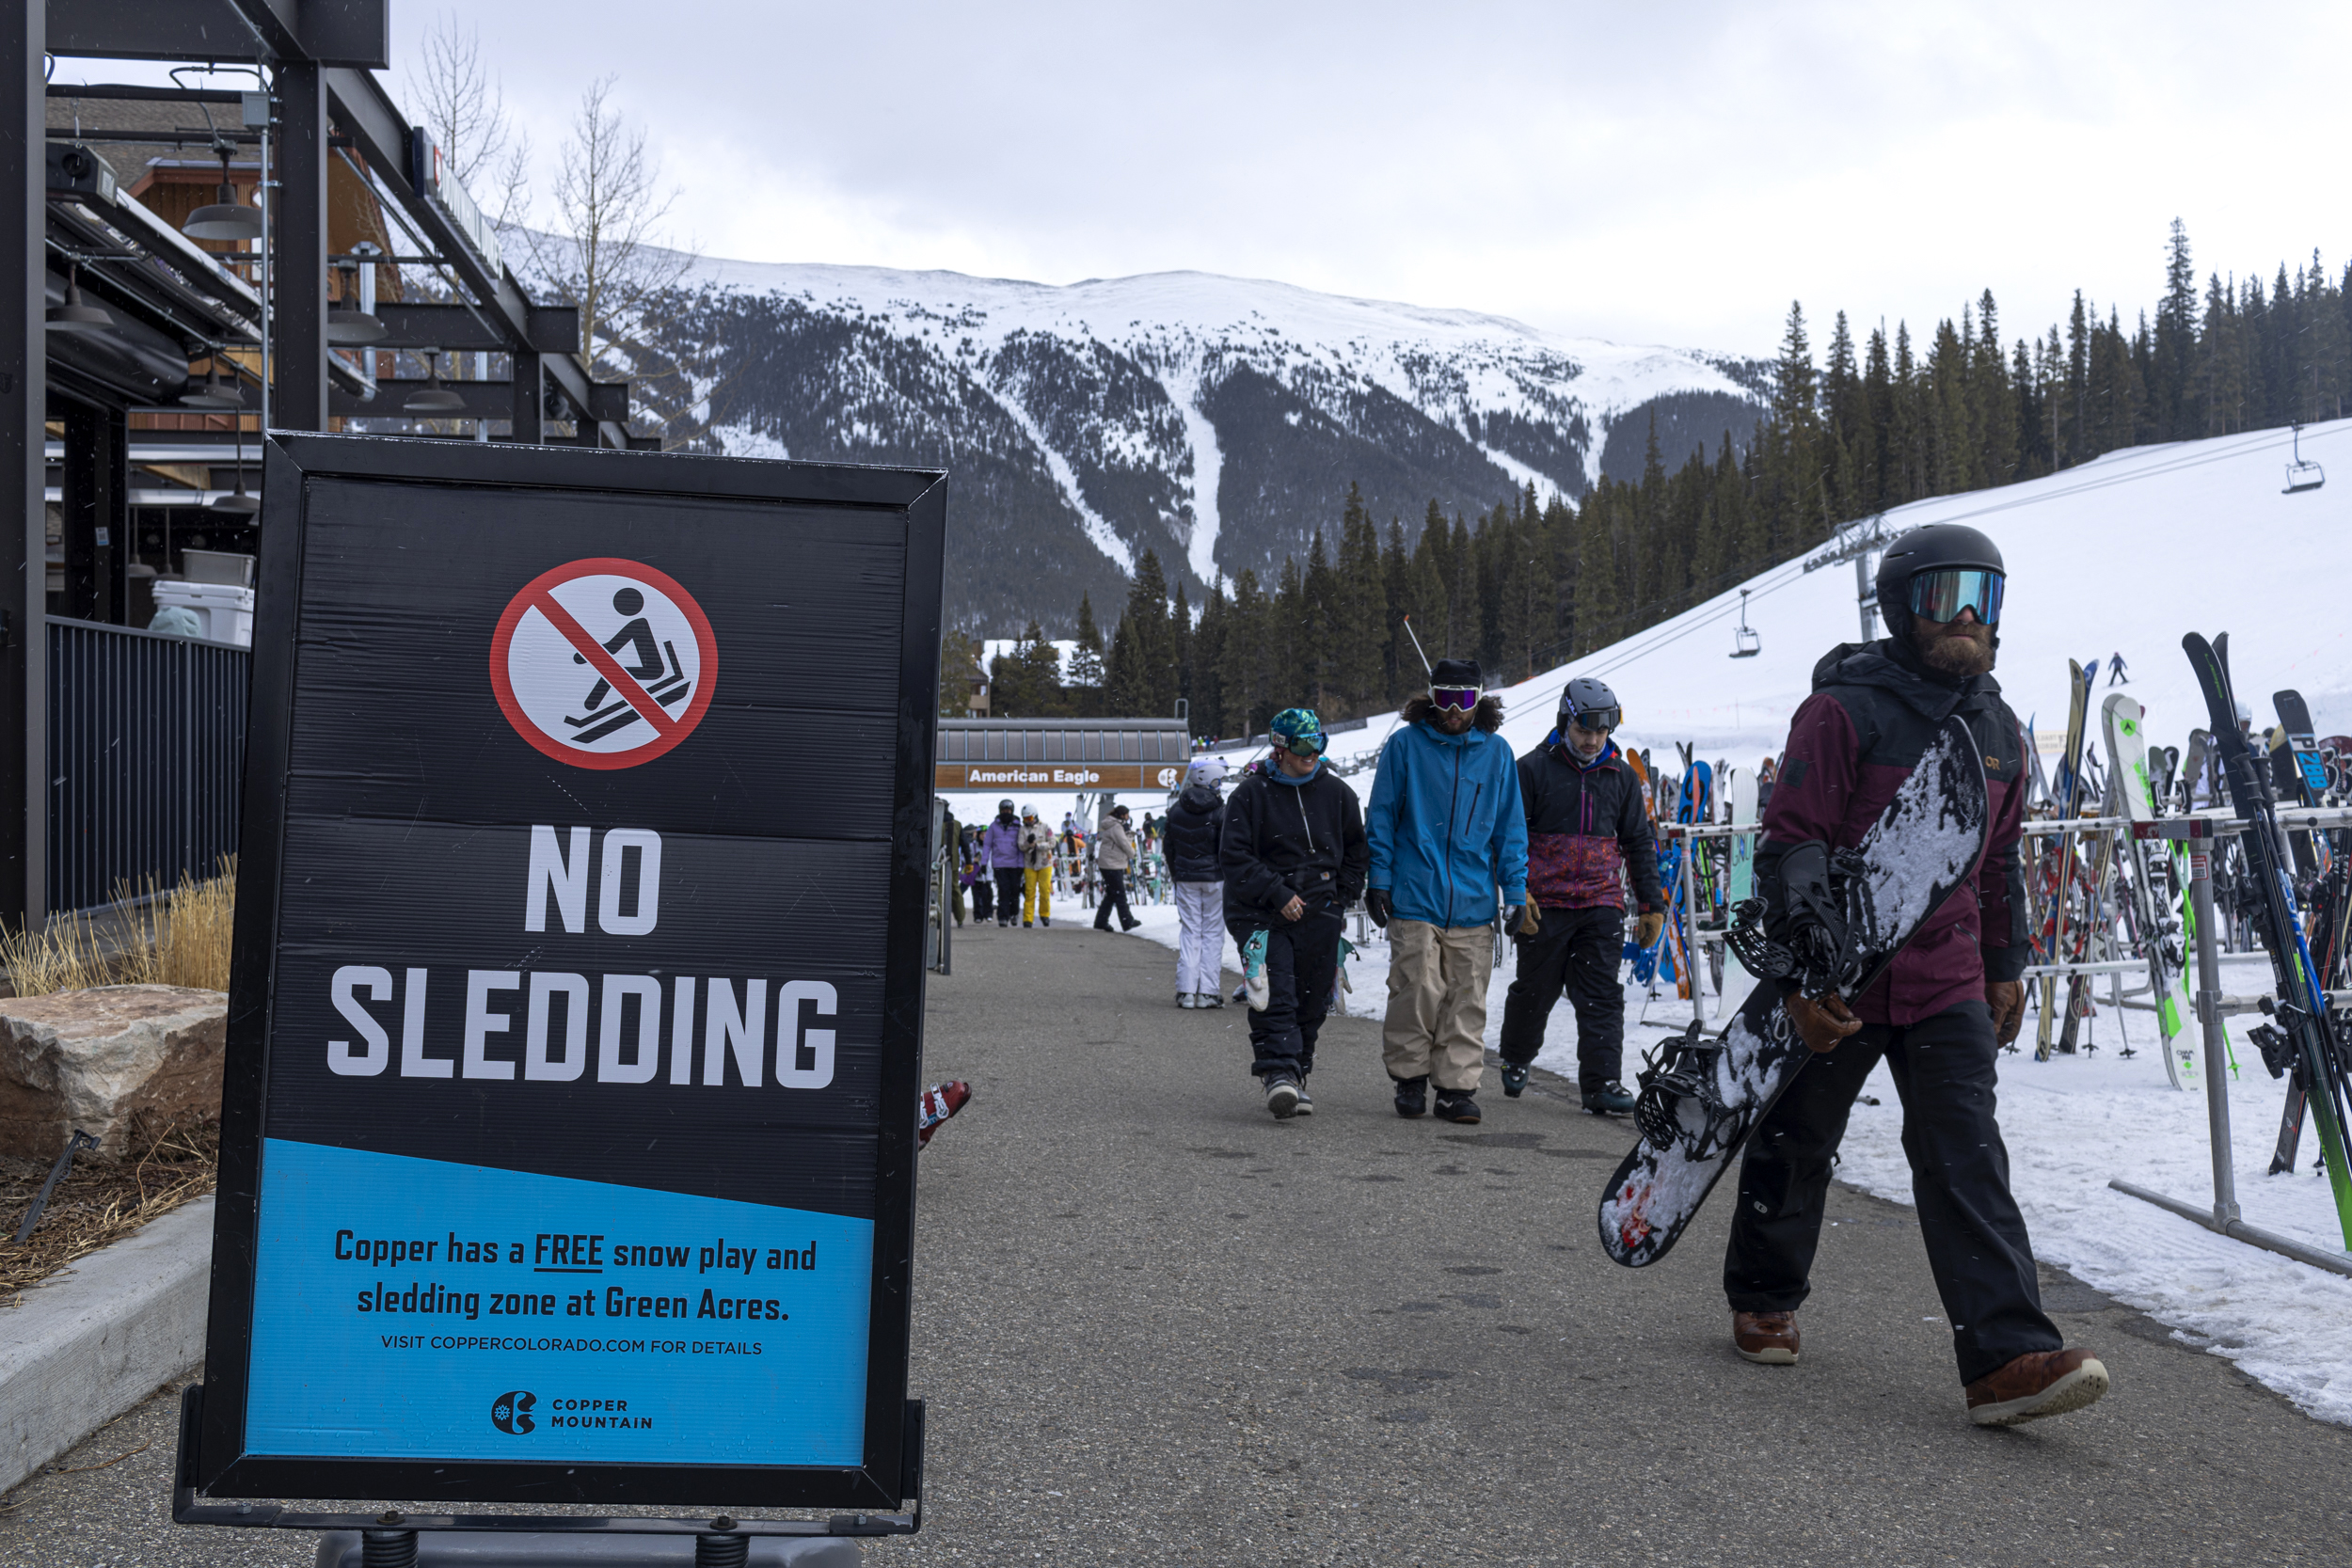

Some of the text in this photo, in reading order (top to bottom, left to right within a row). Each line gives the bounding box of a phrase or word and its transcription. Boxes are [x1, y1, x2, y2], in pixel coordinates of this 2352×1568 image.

[1985, 755, 2000, 770] OR
[970, 769, 1100, 785] American Eagle
[525, 825, 661, 935] NO
[327, 966, 837, 1088] SLEDDING
[335, 1229, 816, 1275] Copper has a FREE snow play and
[358, 1282, 788, 1321] sledding zone at Green Acres.
[381, 1336, 762, 1355] VISIT COPPERCOLORADO.COM FOR DETAILS
[552, 1399, 628, 1412] COPPER
[551, 1416, 653, 1430] MOUNTAIN
